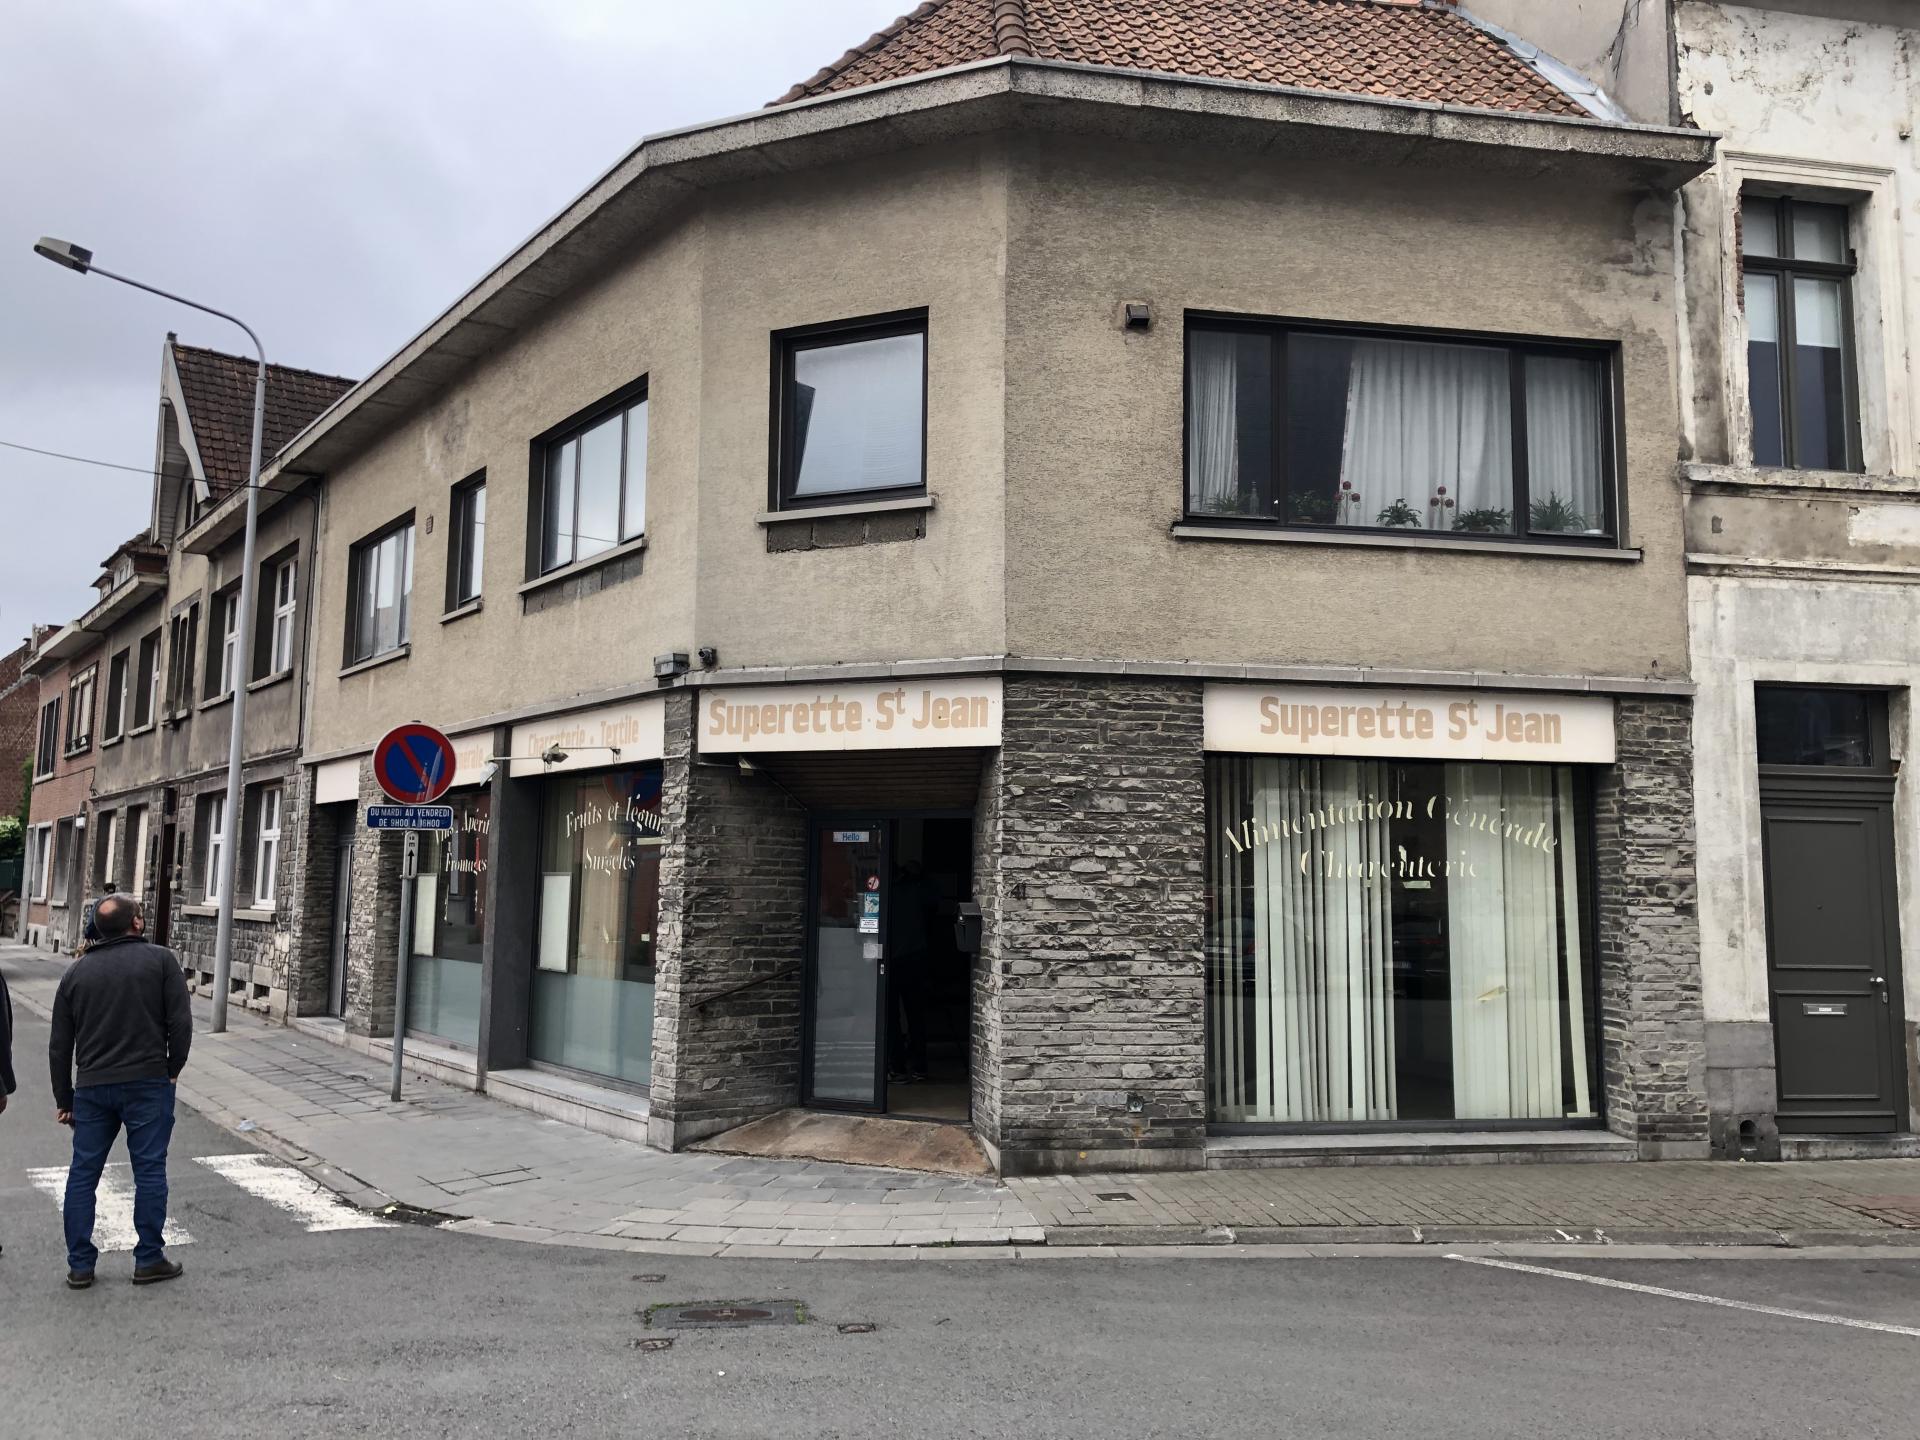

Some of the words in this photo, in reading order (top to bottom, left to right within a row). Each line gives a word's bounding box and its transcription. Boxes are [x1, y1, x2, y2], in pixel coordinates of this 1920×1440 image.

[601, 714, 639, 746] Textile
[709, 695, 862, 742] Superette
[876, 688, 905, 731] St
[912, 690, 989, 729] Jean
[1260, 696, 1434, 743] Superette
[1448, 700, 1478, 740] St
[1486, 704, 1562, 744] Jean
[370, 808, 380, 816] DU
[381, 808, 402, 817] MARDI
[405, 808, 414, 817] AU
[417, 808, 450, 817] VENDREDI
[379, 818, 388, 827] DE
[411, 819, 417, 827] A
[566, 801, 602, 838] Fruits
[608, 802, 619, 821] et
[1225, 794, 1413, 857] Alimentation
[842, 833, 860, 842] Hello
[445, 852, 487, 876] Fromages
[585, 840, 636, 877] Surgelés
[1301, 850, 1477, 879] Charcuterie
